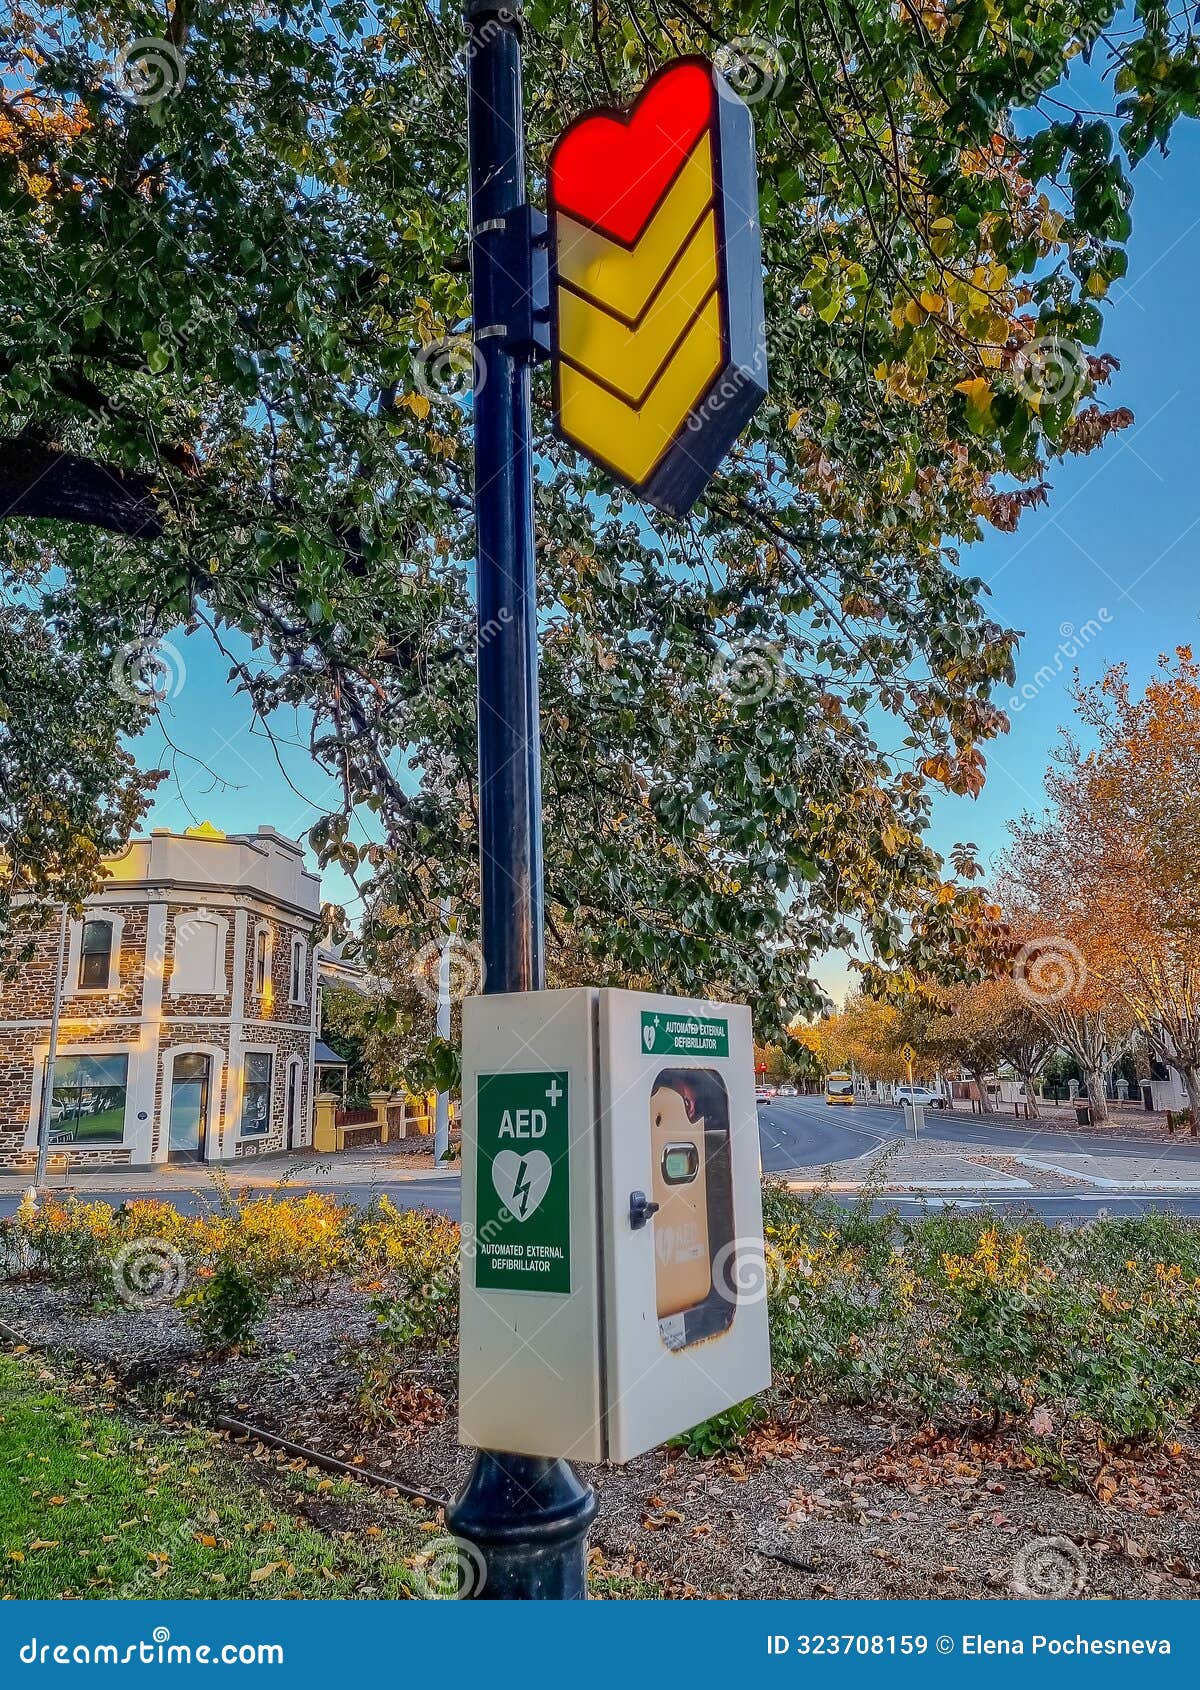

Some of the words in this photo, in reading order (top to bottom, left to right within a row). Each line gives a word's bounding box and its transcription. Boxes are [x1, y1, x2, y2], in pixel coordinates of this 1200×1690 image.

[665, 1021, 698, 1034] AUTOMATED
[700, 1024, 726, 1037] EXTERNAL
[674, 1036, 717, 1050] DEFIBRILLATOR
[498, 1109, 547, 1138] AED
[481, 1243, 524, 1256] AUTOMATED
[526, 1245, 564, 1259] EXTERNAL
[491, 1258, 551, 1272] DEFIBRILLATOR
